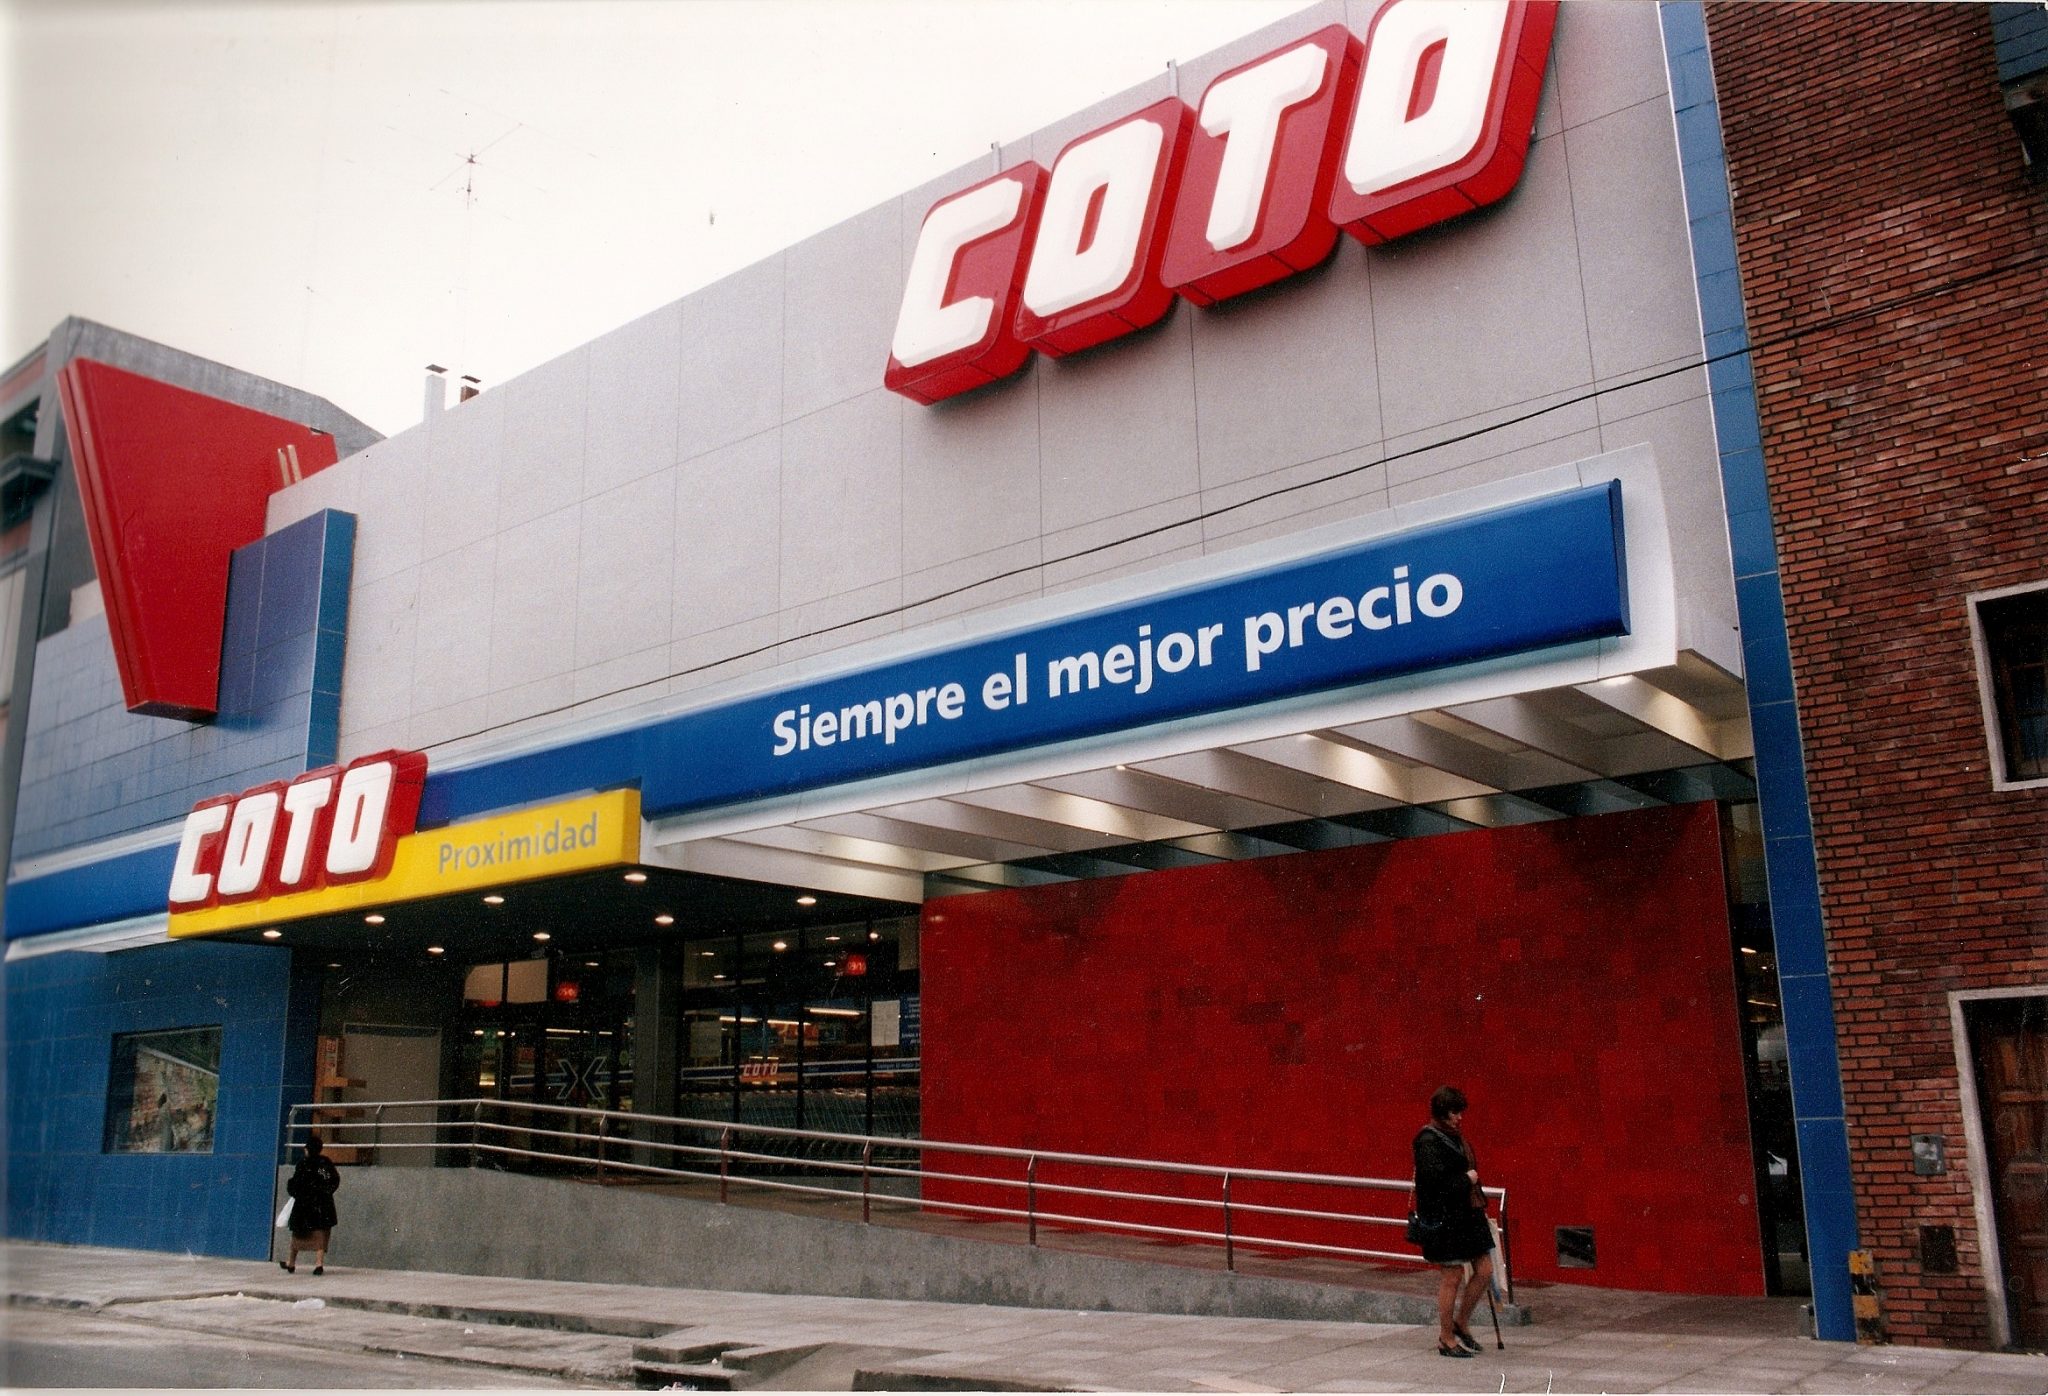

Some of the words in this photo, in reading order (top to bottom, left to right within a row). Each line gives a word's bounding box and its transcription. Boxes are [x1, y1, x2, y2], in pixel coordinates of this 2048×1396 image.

[892, 2, 1508, 367] COTO
[772, 682, 965, 756] Siempre
[982, 653, 1028, 710] el
[1049, 623, 1224, 694] mejor
[1244, 564, 1464, 672] precio
[169, 759, 394, 904] COTO
[438, 811, 599, 874] Proximidad
[742, 1062, 779, 1077] COTO
